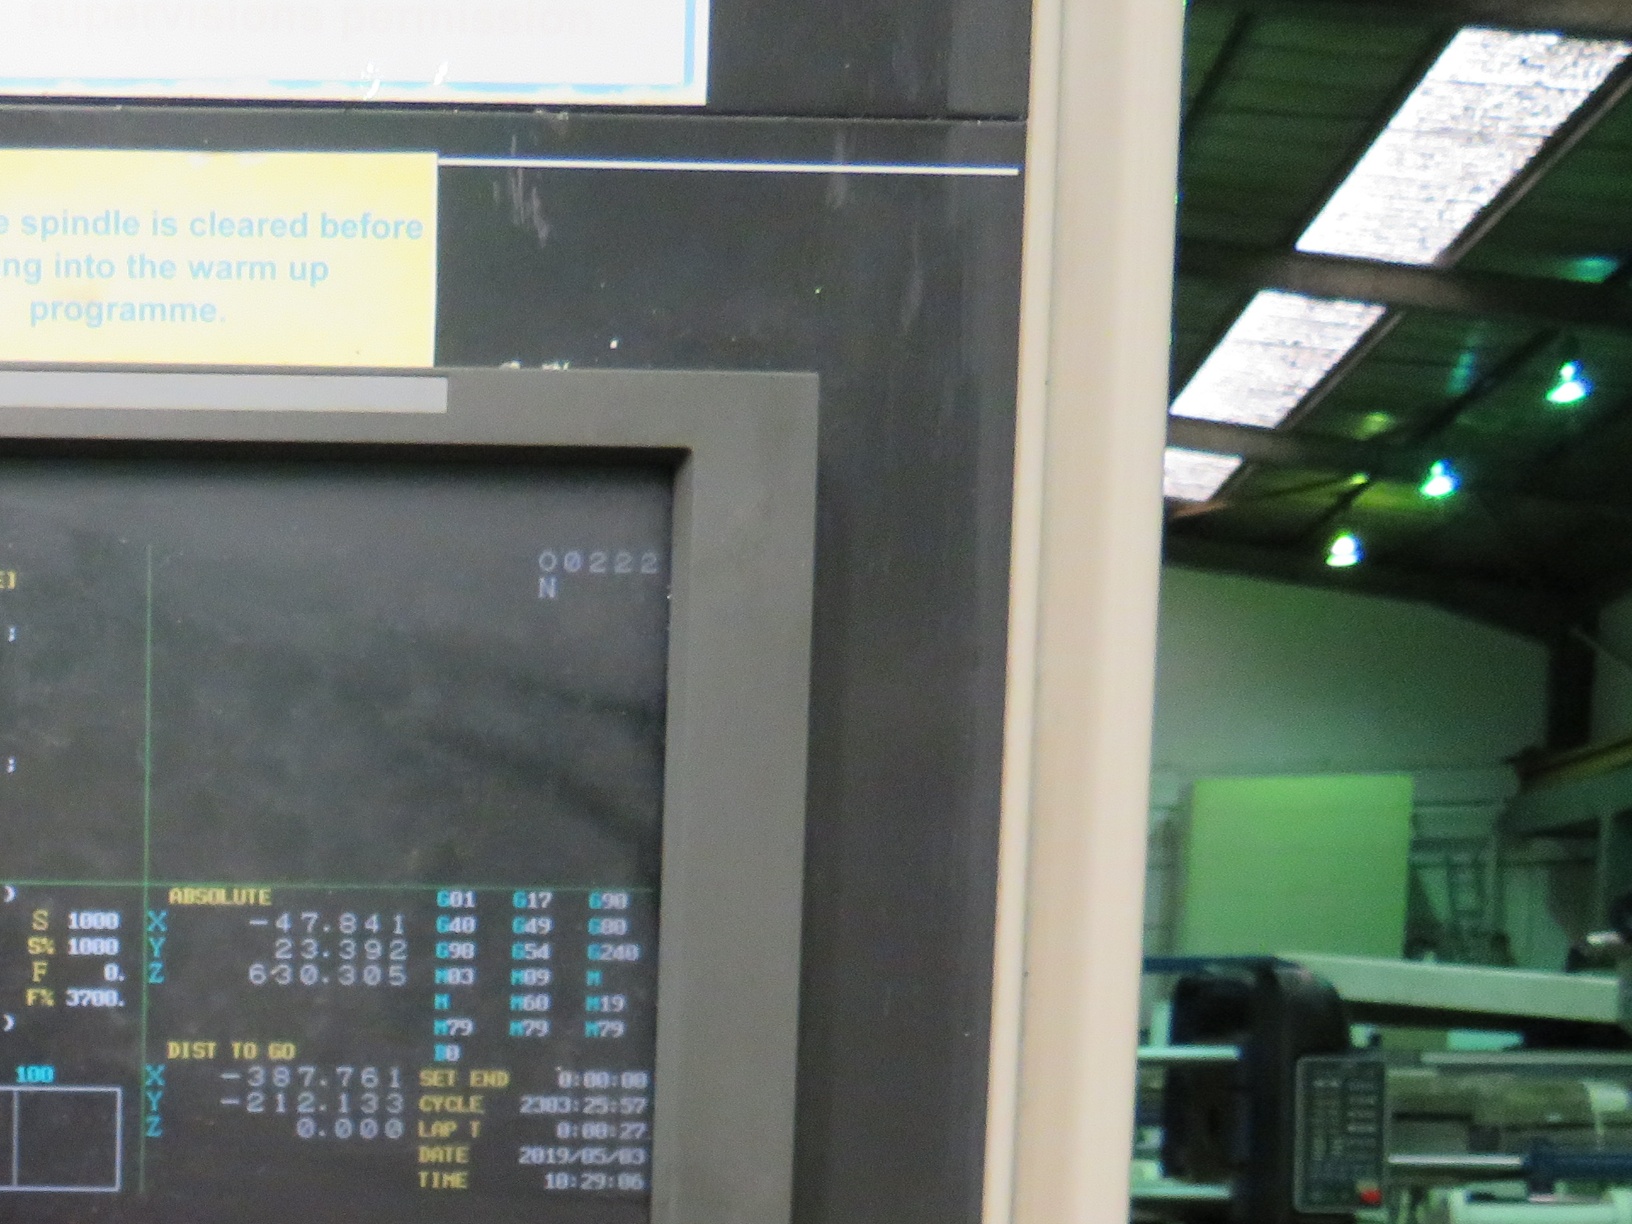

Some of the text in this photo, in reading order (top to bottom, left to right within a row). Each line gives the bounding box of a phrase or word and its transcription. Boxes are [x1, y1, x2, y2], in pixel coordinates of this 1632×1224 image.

[21, 209, 140, 242] spindle
[152, 210, 178, 237] is
[189, 210, 309, 238] cleared
[321, 212, 424, 240] before
[54, 251, 116, 279] into
[127, 253, 176, 279] the
[189, 259, 276, 281] warm
[289, 261, 330, 288] up
[30, 300, 226, 328] programme.
[169, 885, 270, 905] ABSOLUTE
[69, 911, 120, 929] 1000
[249, 911, 403, 934] -47.841
[69, 937, 119, 955] 1000
[275, 937, 407, 961] 23.392
[249, 962, 406, 986] 630.305
[168, 1042, 295, 1060] DIST TO GO
[18, 1066, 54, 1083] 100
[221, 1065, 400, 1088] -387.761
[420, 1070, 509, 1087] SET END
[221, 1090, 403, 1114] -212.133
[419, 1095, 483, 1113] CYCLE
[297, 1116, 403, 1139] 0.000
[419, 1146, 467, 1163] DATE
[419, 1171, 467, 1188] TIME
